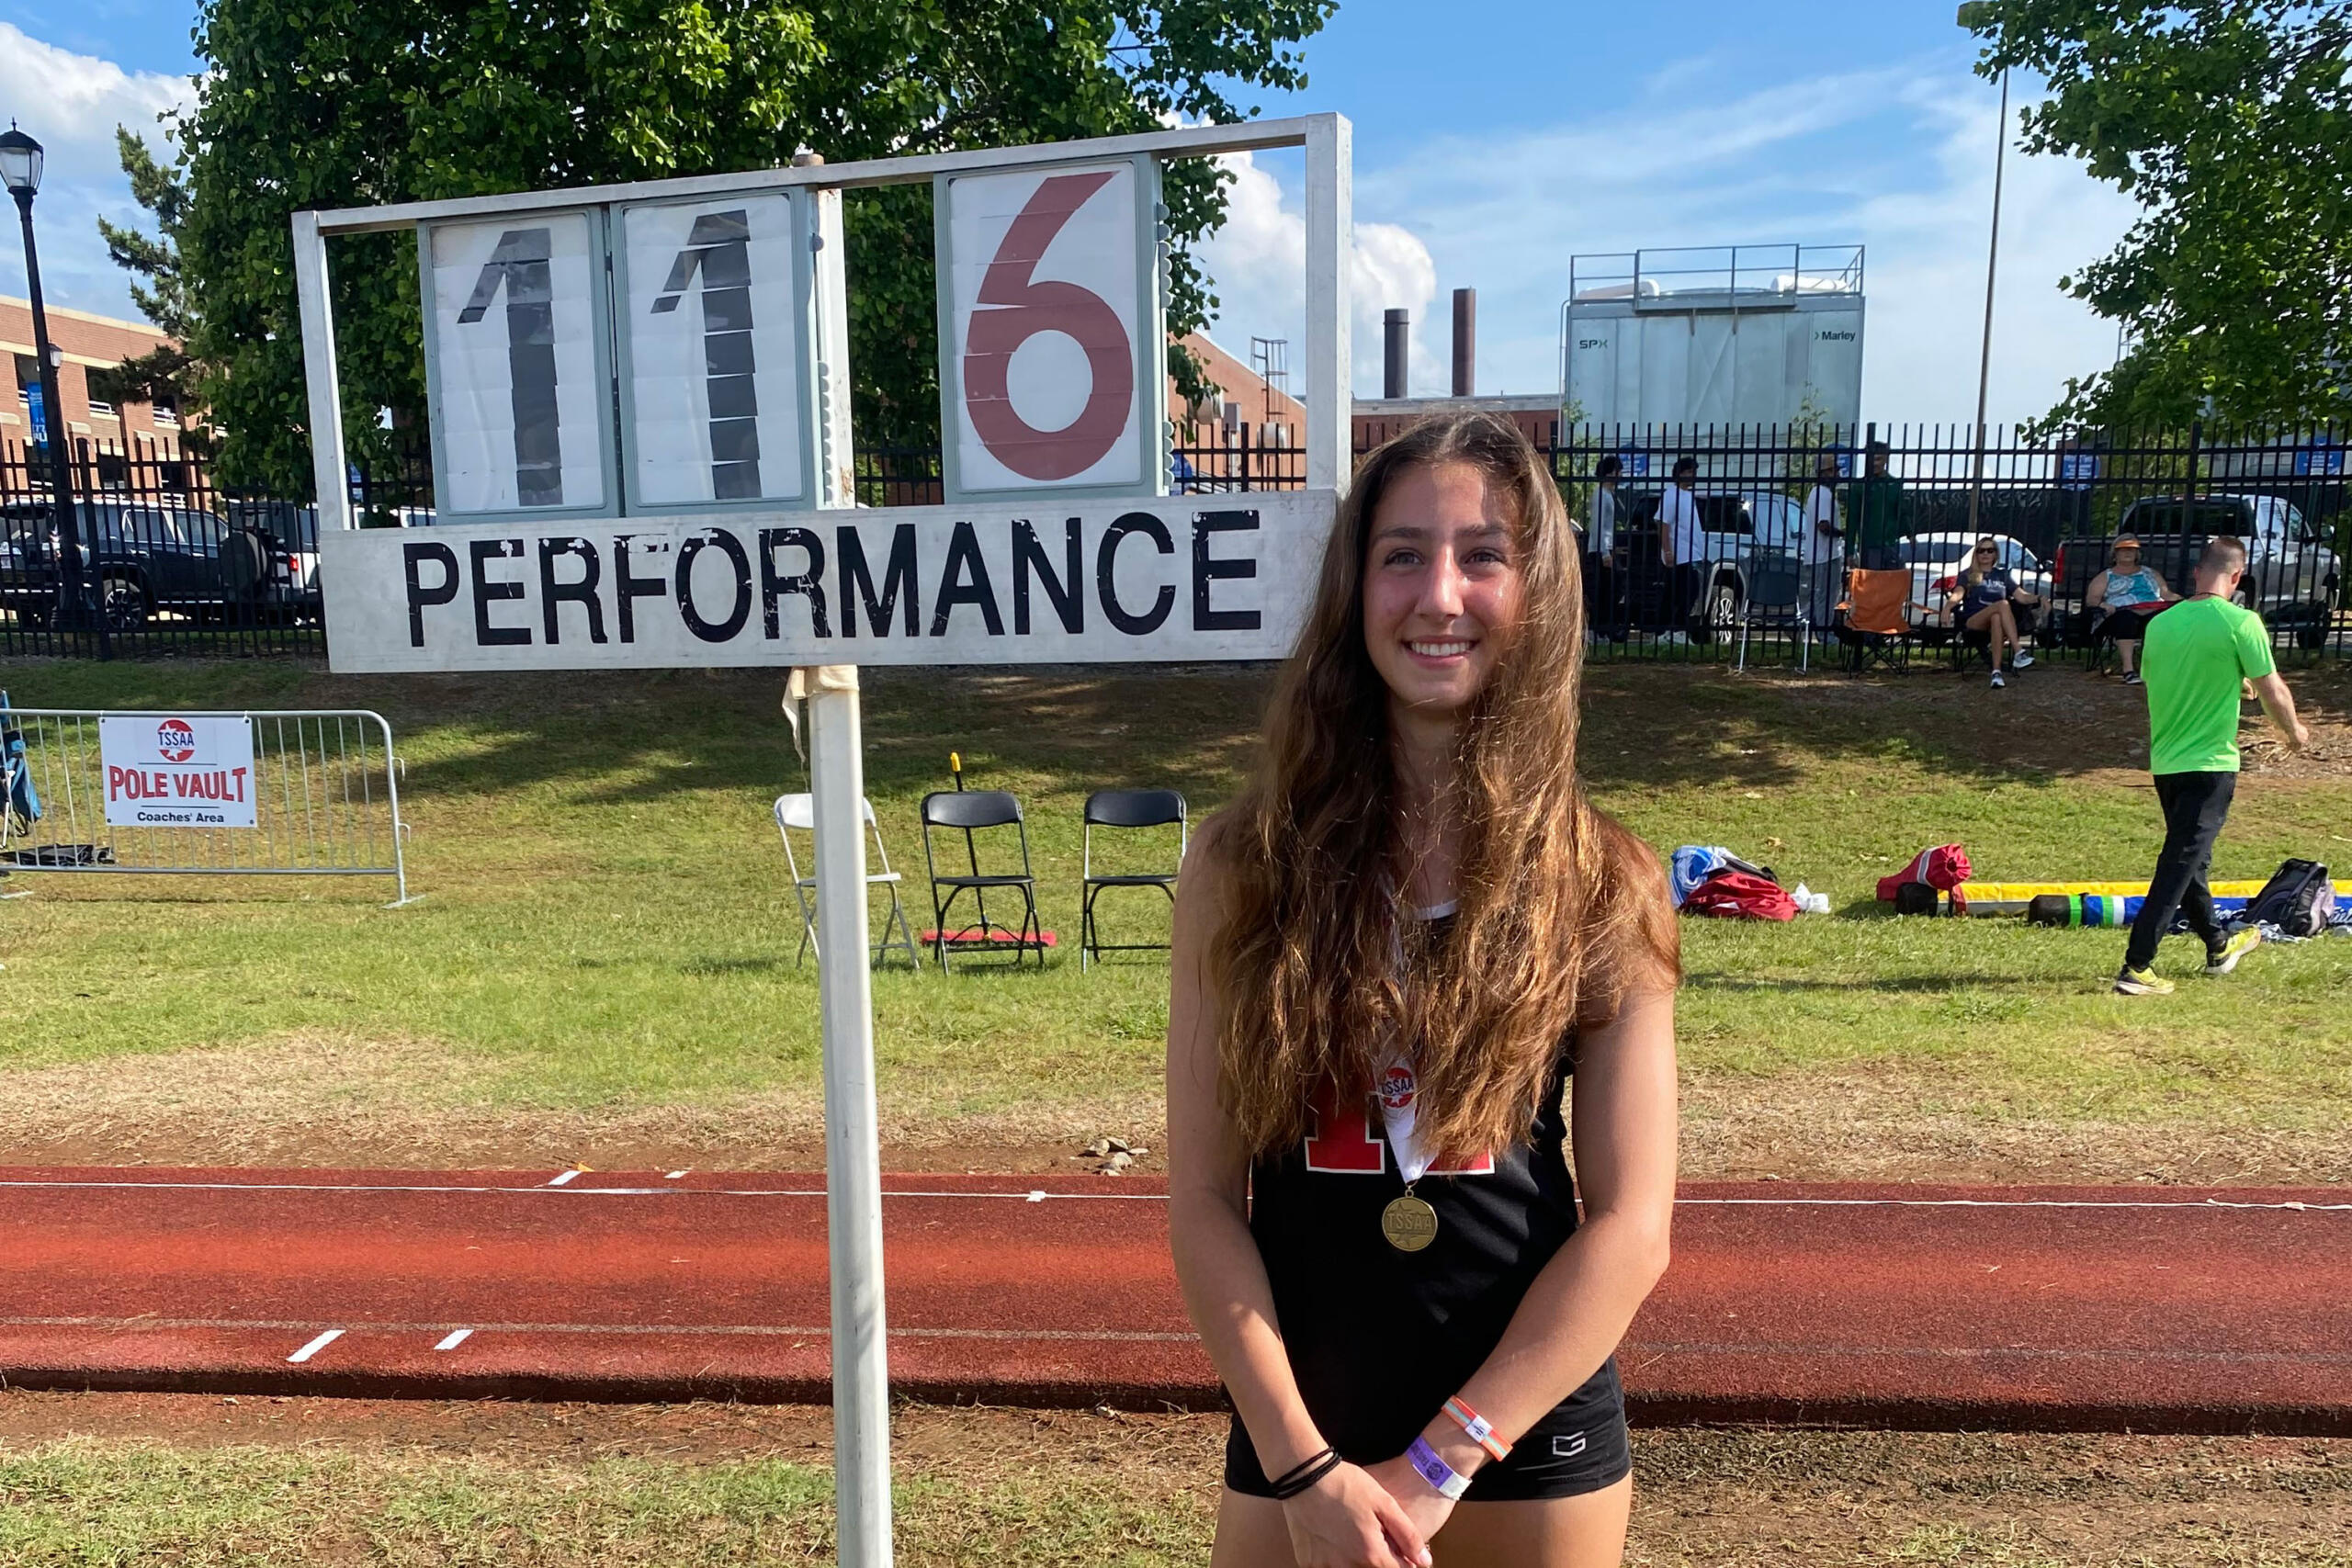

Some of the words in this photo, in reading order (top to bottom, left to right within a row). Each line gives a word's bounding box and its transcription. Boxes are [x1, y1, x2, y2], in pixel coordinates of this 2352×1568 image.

[963, 170, 1134, 481] 6
[1579, 339, 1608, 350] SPX
[1821, 331, 1856, 343] Marley
[404, 510, 1261, 646] PERFORMANCE
[157, 731, 195, 746] TSSAA
[109, 765, 168, 802] POLE
[173, 767, 246, 802] VAULT
[137, 812, 192, 822] Coaches'
[196, 812, 224, 822] Area
[1386, 1213, 1432, 1230] TSSAA
